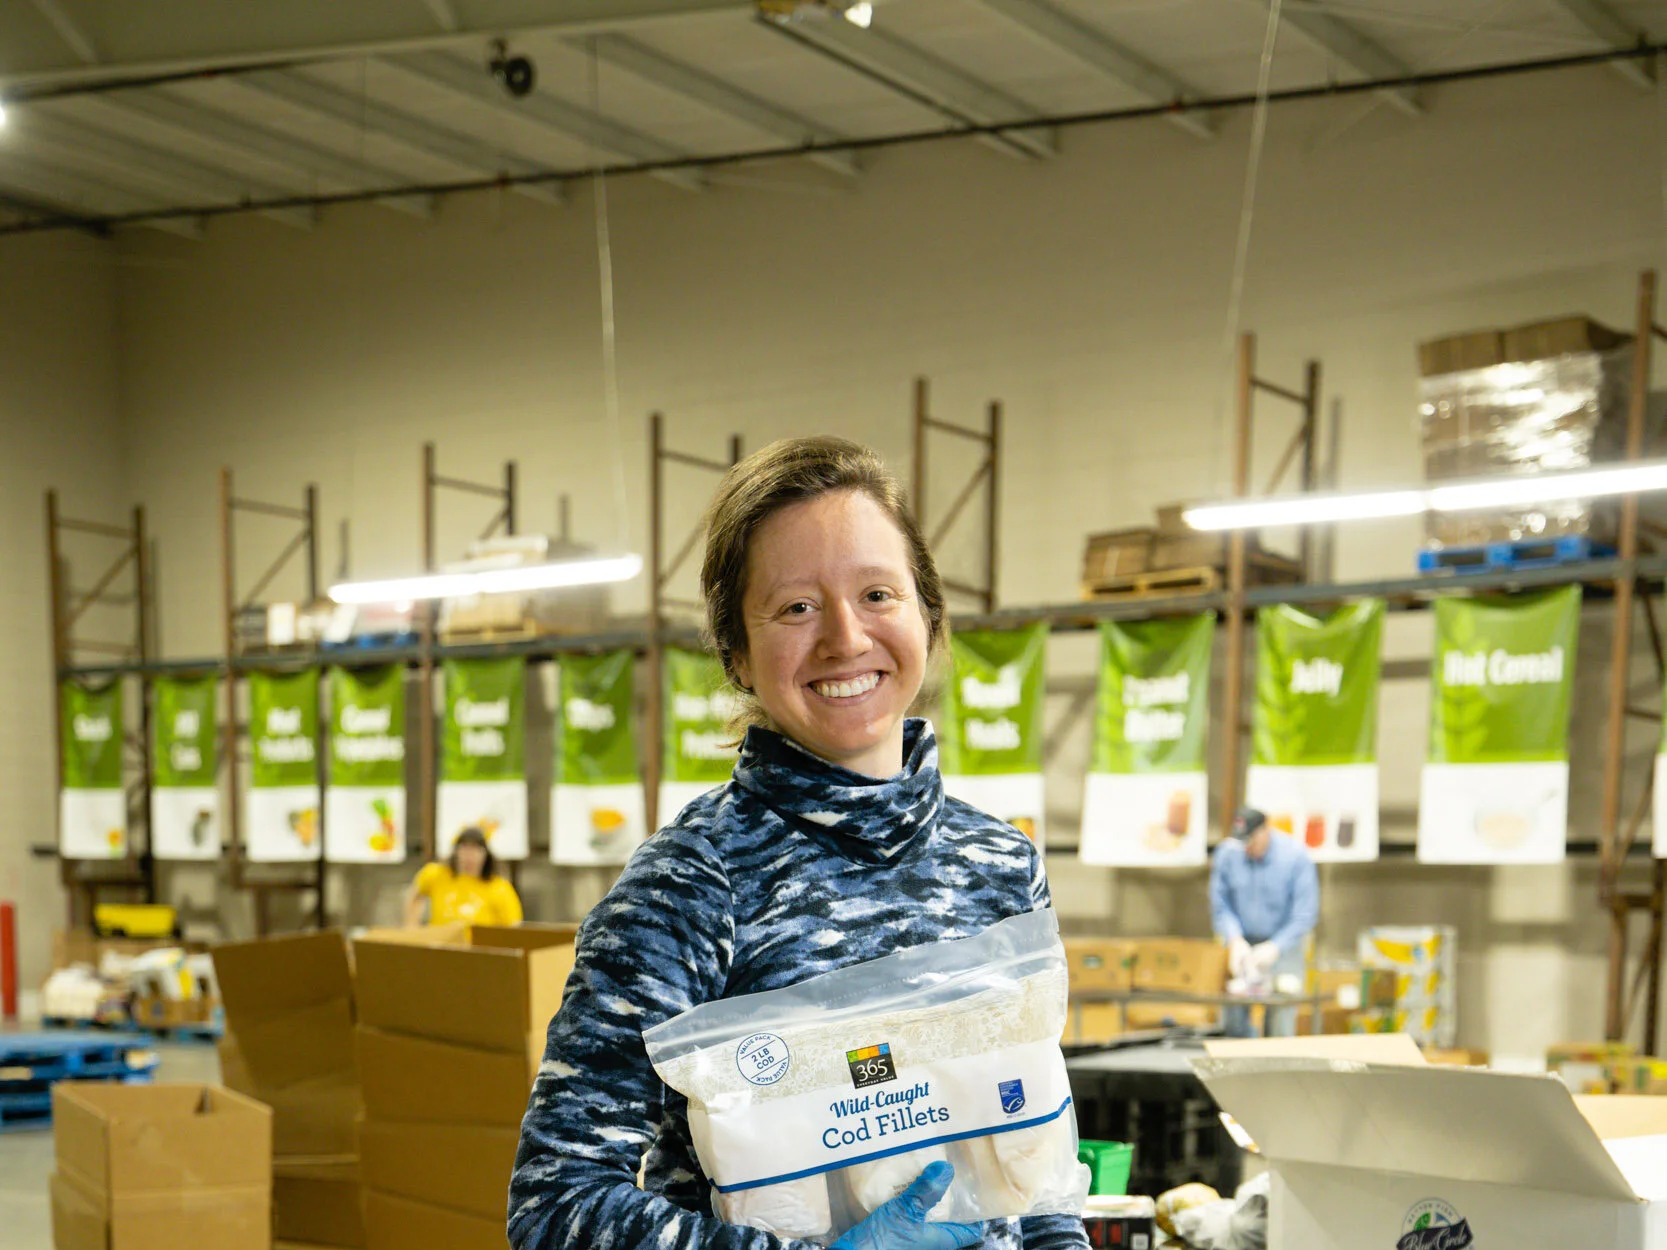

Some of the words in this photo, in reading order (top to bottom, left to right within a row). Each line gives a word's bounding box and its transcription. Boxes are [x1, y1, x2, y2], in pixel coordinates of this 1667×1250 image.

[739, 1039, 755, 1055] VALUE
[751, 1054, 758, 1063] 2
[757, 1048, 770, 1058] LB
[756, 1055, 775, 1070] COD
[773, 1061, 787, 1078] VALUE
[856, 1058, 888, 1082] 365
[829, 1082, 930, 1118] Wild-Caught
[822, 1117, 872, 1149] Cod
[875, 1106, 950, 1136] Fillets
